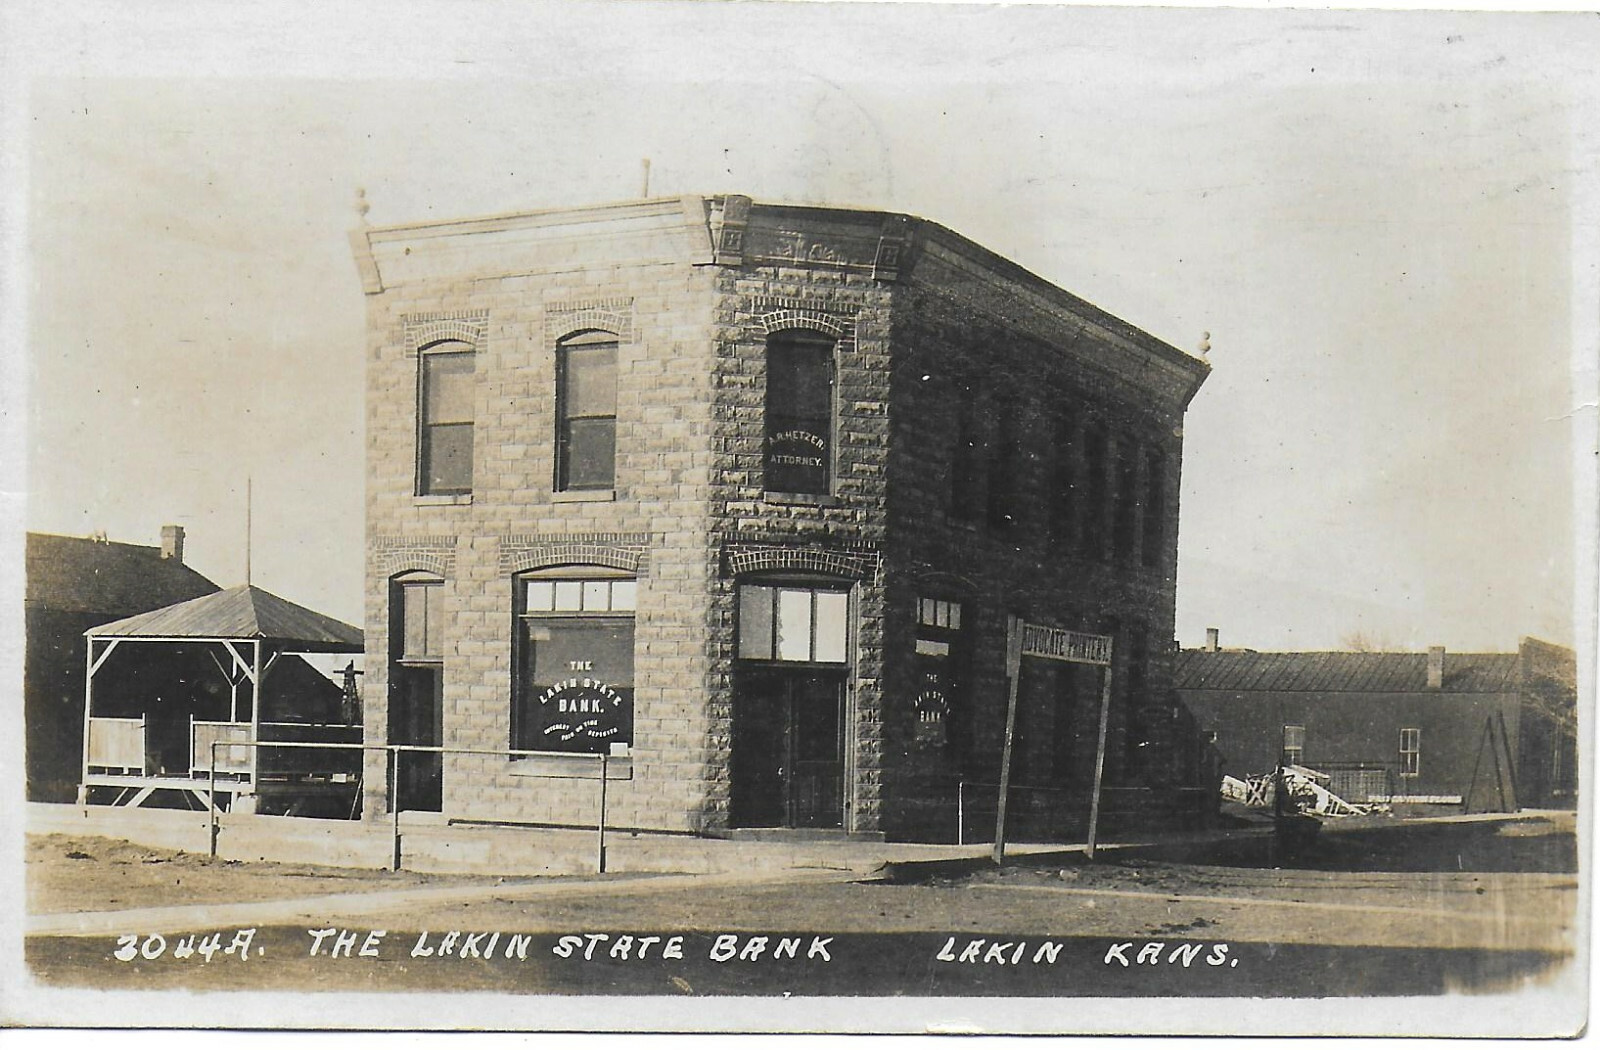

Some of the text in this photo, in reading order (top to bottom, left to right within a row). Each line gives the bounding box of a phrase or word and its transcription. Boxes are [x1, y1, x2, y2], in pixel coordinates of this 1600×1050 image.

[570, 660, 592, 671] THE
[539, 678, 622, 707] LAKIN STATE
